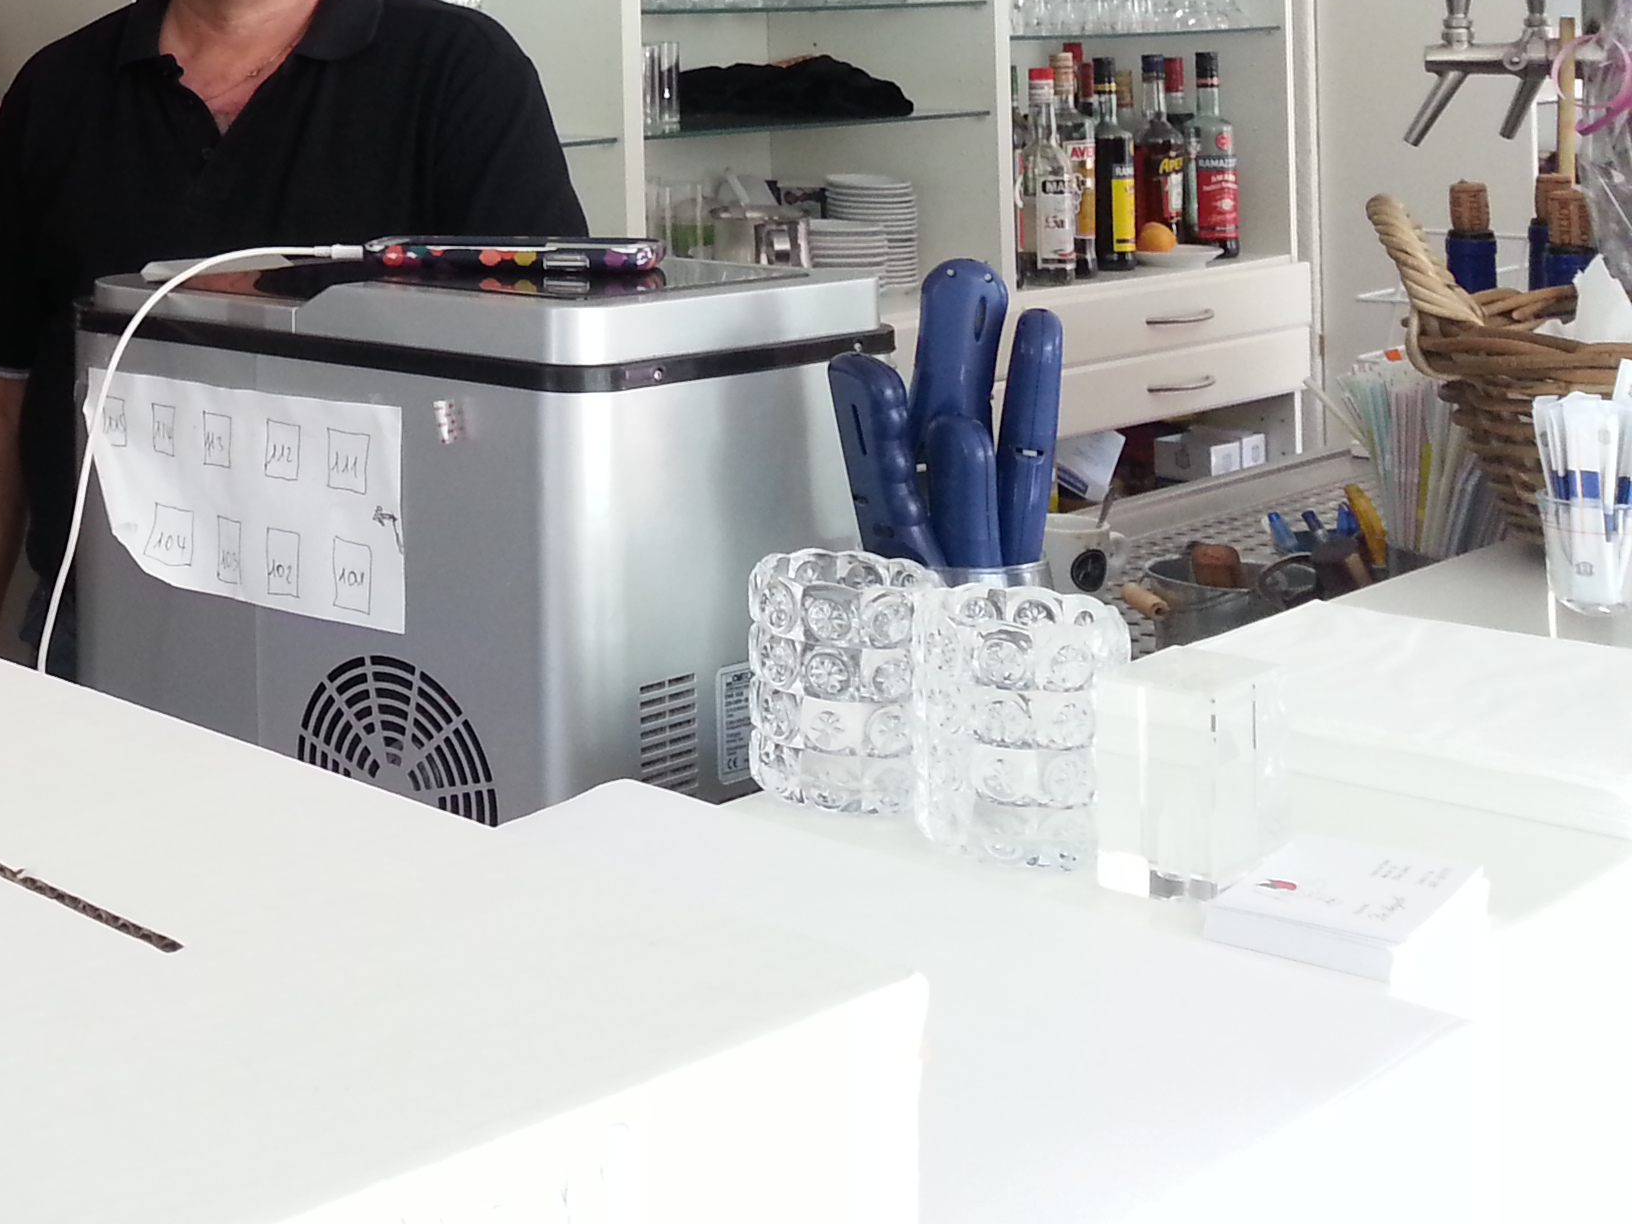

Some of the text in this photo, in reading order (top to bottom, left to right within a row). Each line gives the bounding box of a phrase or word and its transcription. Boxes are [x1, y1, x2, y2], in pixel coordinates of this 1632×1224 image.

[267, 444, 294, 464] 112
[330, 451, 358, 478] 111
[153, 531, 188, 551] 104
[267, 559, 293, 584] 102
